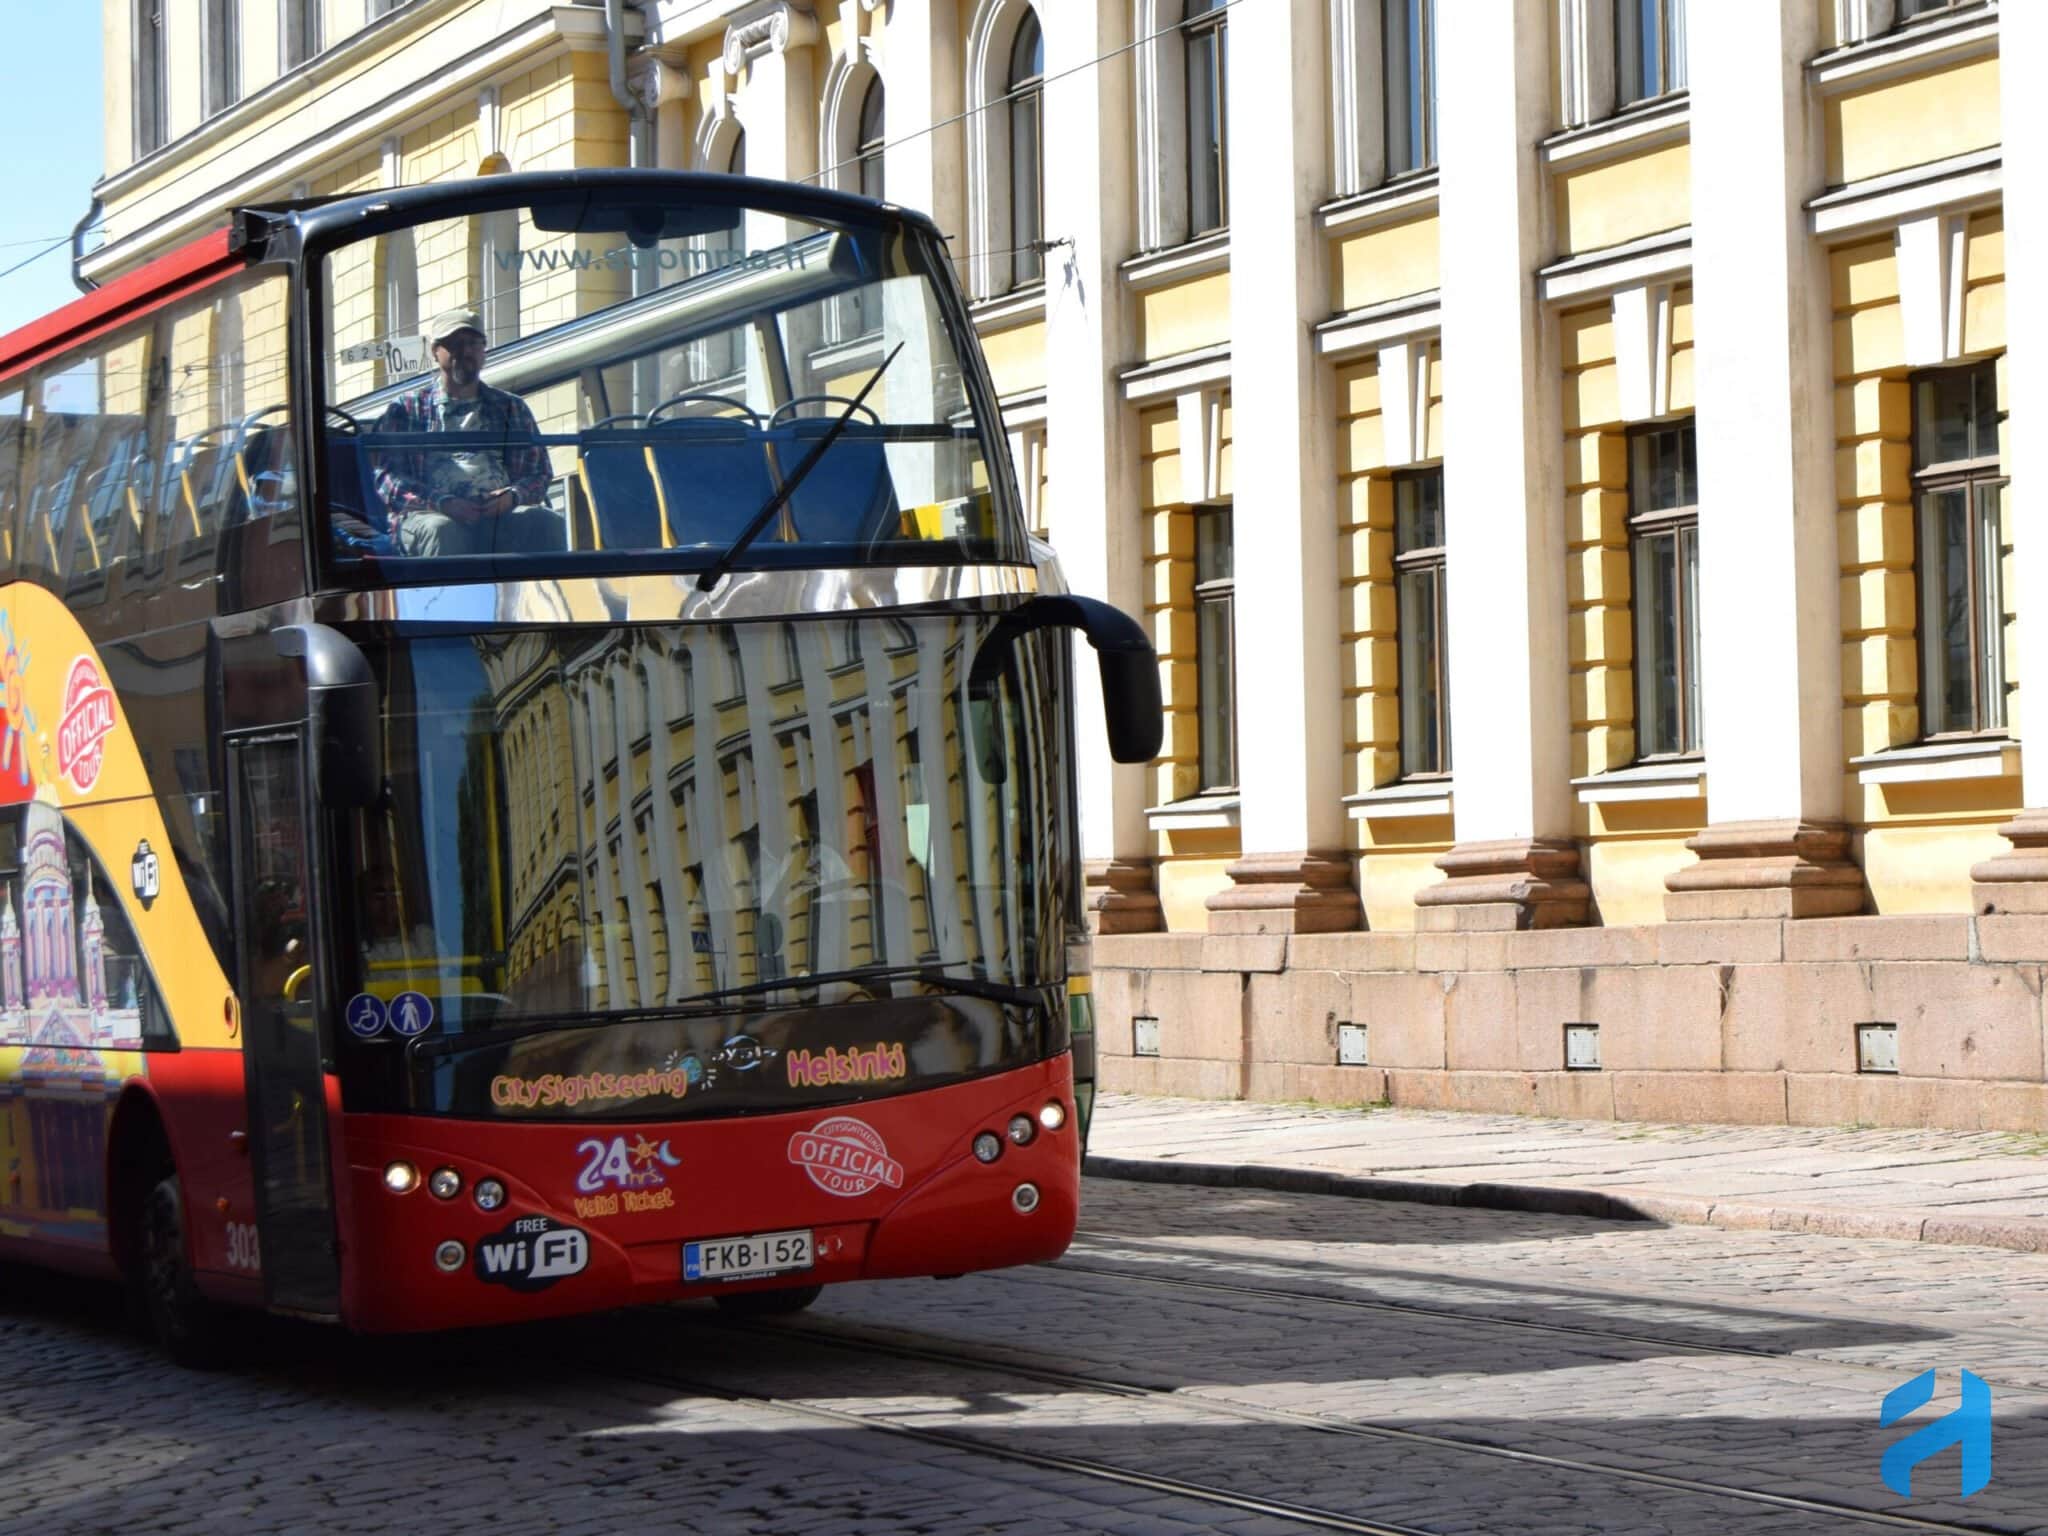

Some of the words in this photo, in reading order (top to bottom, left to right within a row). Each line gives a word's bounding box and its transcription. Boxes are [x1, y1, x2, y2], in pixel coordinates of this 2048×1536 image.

[62, 694, 113, 764] OFFICIAL
[787, 1042, 907, 1088] Helsinki
[490, 1069, 688, 1108] CitySightseeing
[576, 1136, 632, 1192] 24
[800, 1139, 896, 1185] OFFICIAL
[823, 1170, 868, 1192] TOUR
[574, 1193, 620, 1219] Valid
[622, 1187, 676, 1213] Ticket
[225, 1221, 261, 1270] 303
[515, 1217, 549, 1235] FREE
[482, 1233, 582, 1274] WiFi
